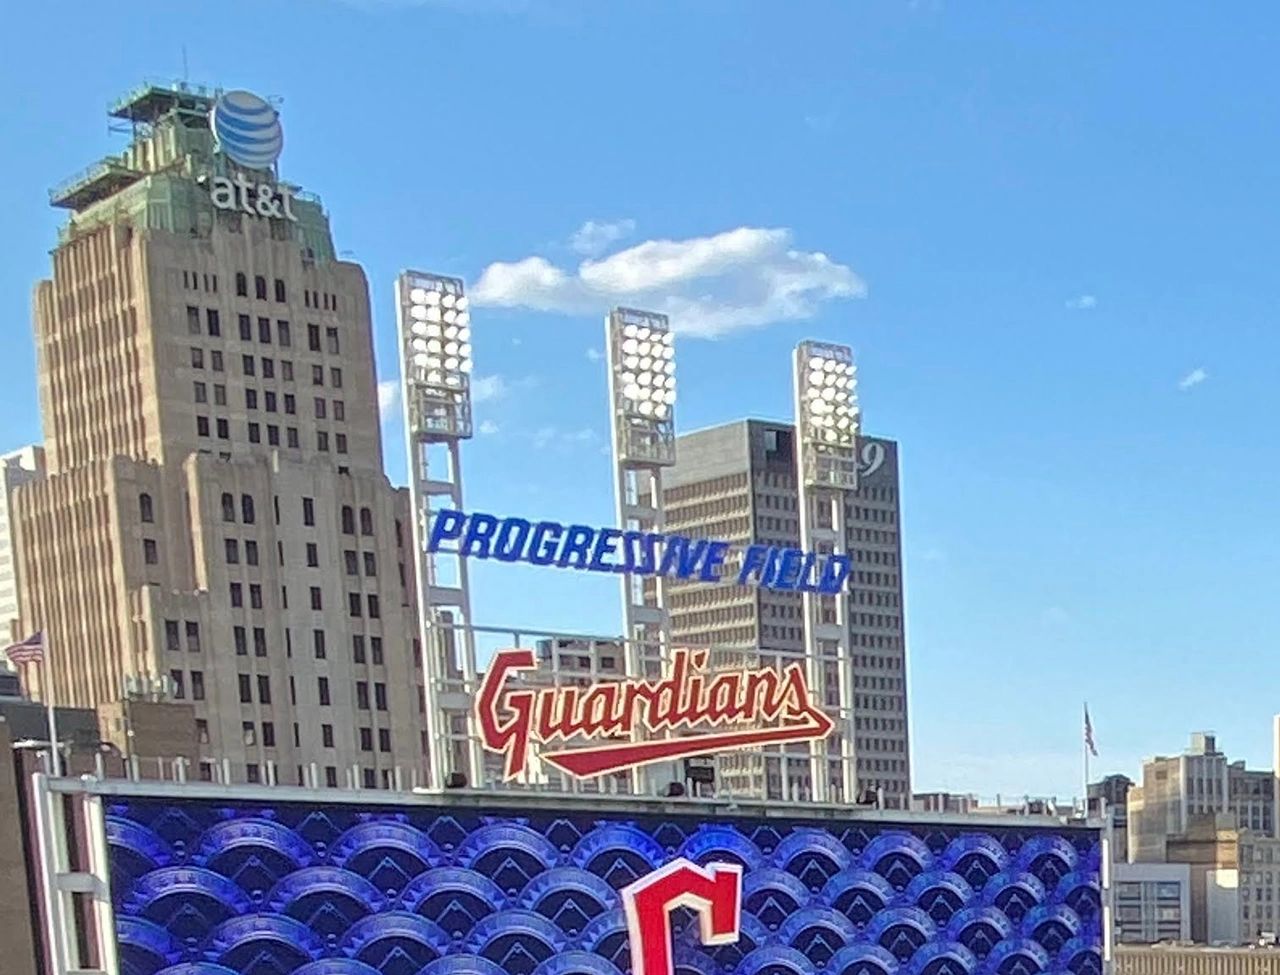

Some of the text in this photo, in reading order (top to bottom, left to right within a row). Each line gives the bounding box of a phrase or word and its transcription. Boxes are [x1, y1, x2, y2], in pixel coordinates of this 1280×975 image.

[211, 173, 298, 221] at&t
[426, 508, 852, 594] PROGRESSIVE FIELD
[475, 648, 835, 782] Guardians
